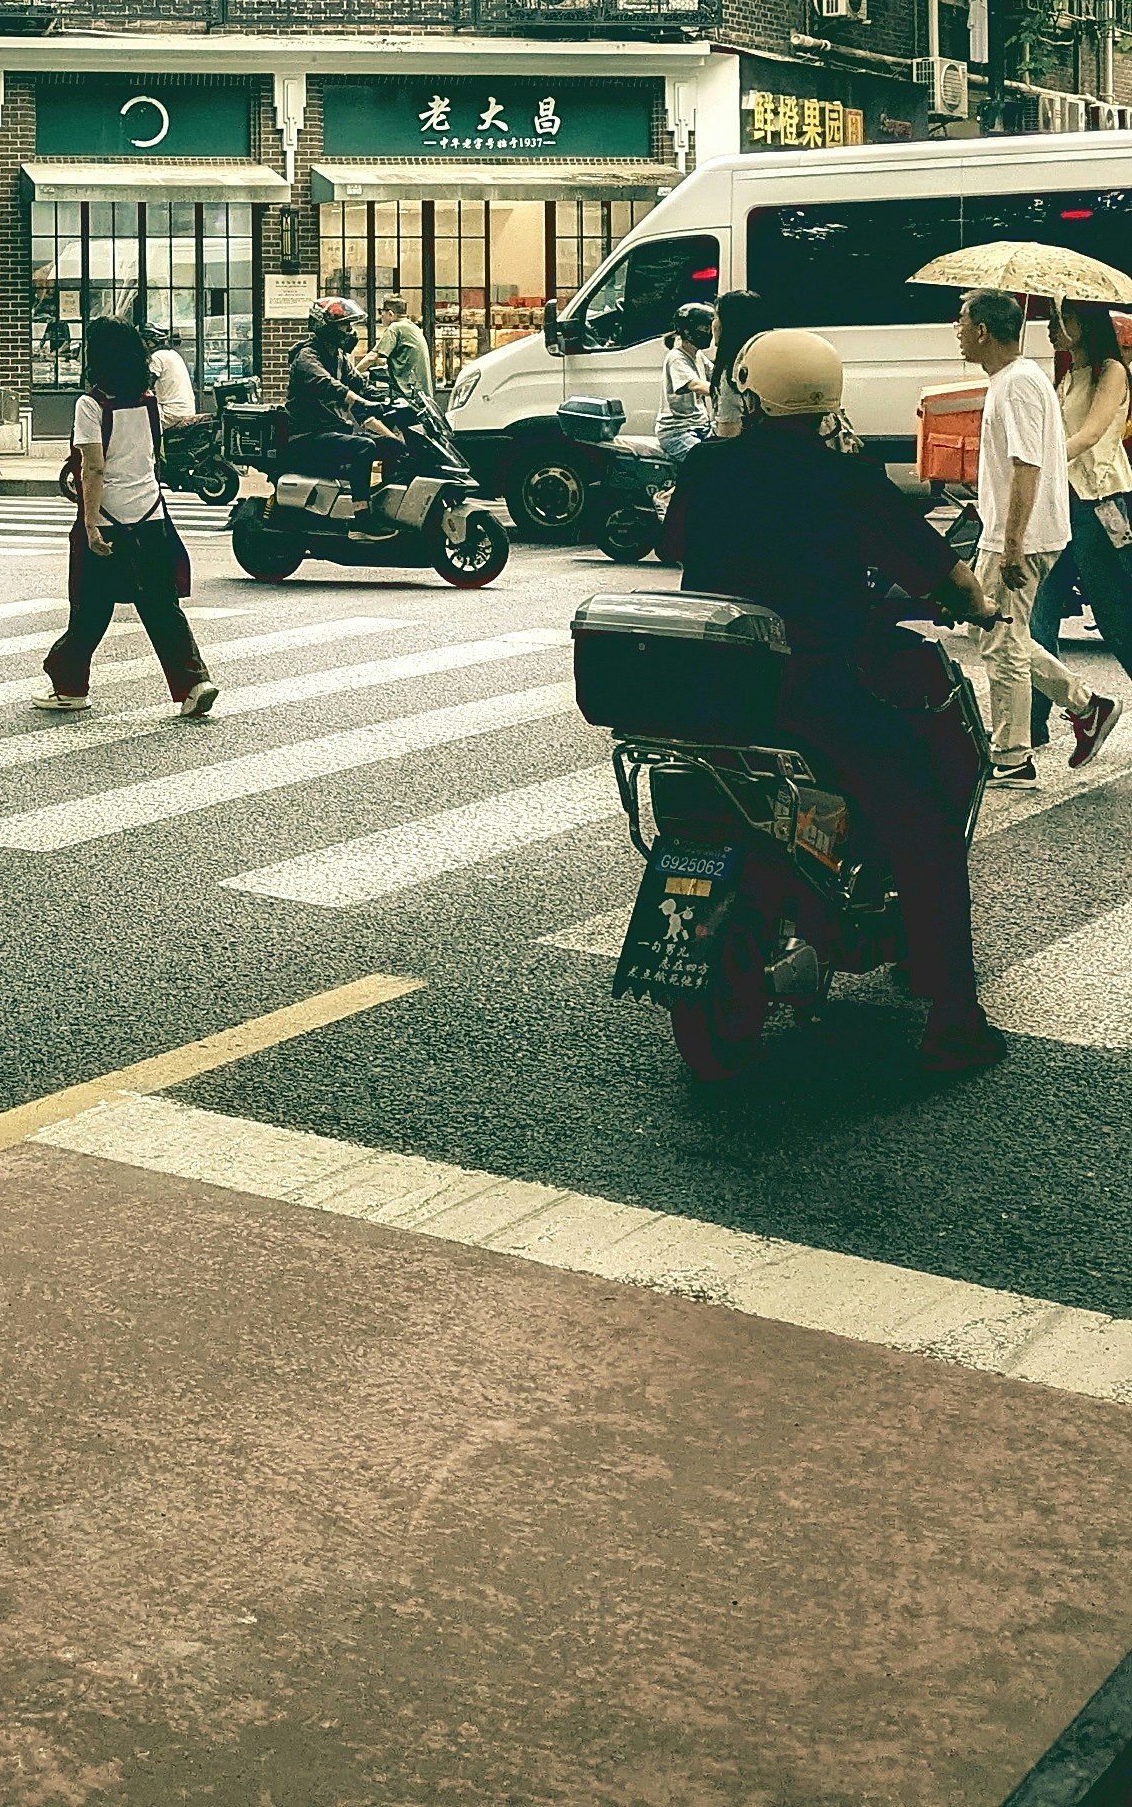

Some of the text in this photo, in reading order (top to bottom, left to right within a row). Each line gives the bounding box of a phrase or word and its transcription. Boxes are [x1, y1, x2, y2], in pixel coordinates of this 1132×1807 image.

[418, 95, 561, 135] 老大昌
[753, 92, 844, 148] 鲜橙果园
[660, 854, 725, 877] G925062
